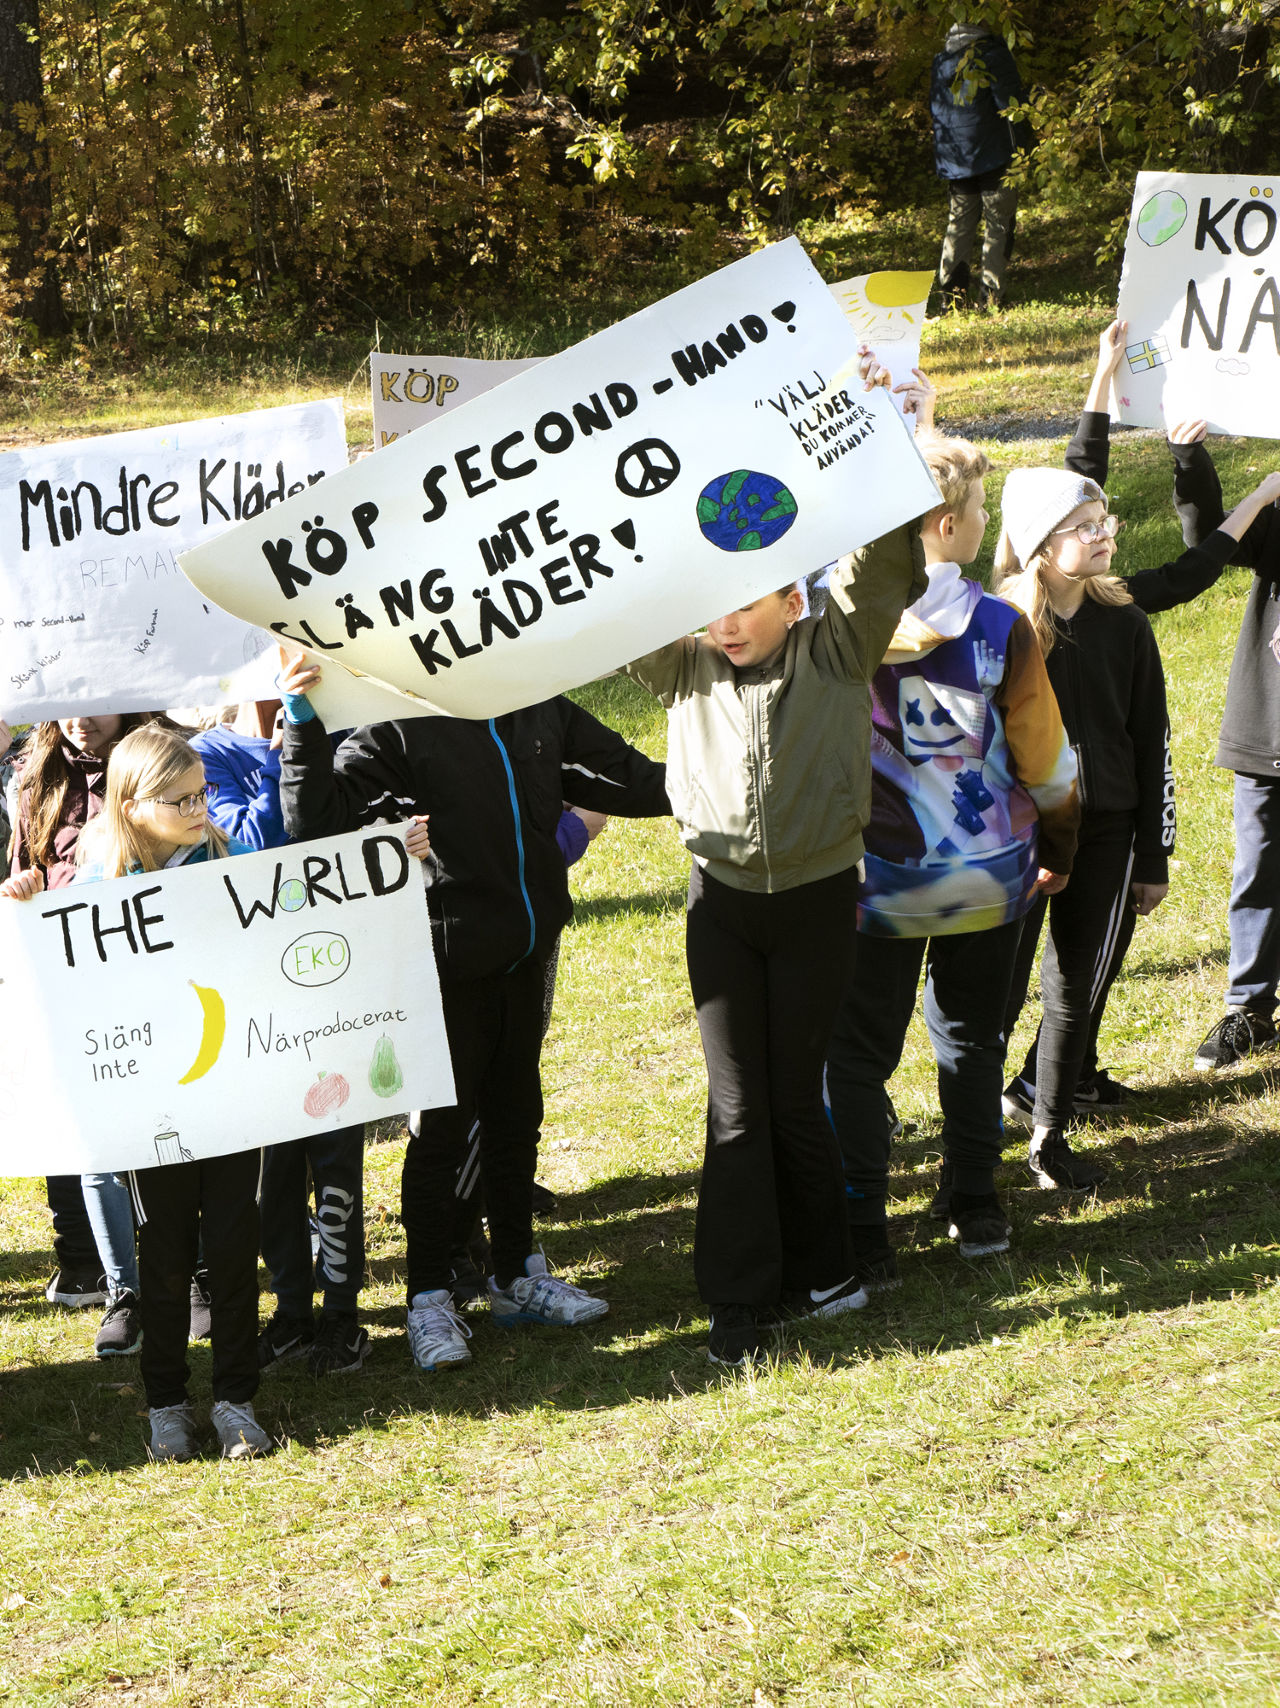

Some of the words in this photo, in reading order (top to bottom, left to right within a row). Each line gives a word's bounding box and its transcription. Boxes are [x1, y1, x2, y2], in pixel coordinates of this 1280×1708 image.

[1194, 186, 1277, 257] KÖ
[380, 368, 460, 406] KÖP
[789, 389, 855, 441] KLÄDER
[802, 438, 819, 456] DU
[819, 406, 867, 442] KOMMER
[18, 466, 181, 552] Mindre
[262, 500, 380, 600] KÖP
[270, 568, 455, 650] SLÄNG
[479, 499, 569, 577] INTE
[409, 518, 645, 677] KLÄDER!
[42, 885, 174, 968] THE
[294, 939, 347, 977] EKO
